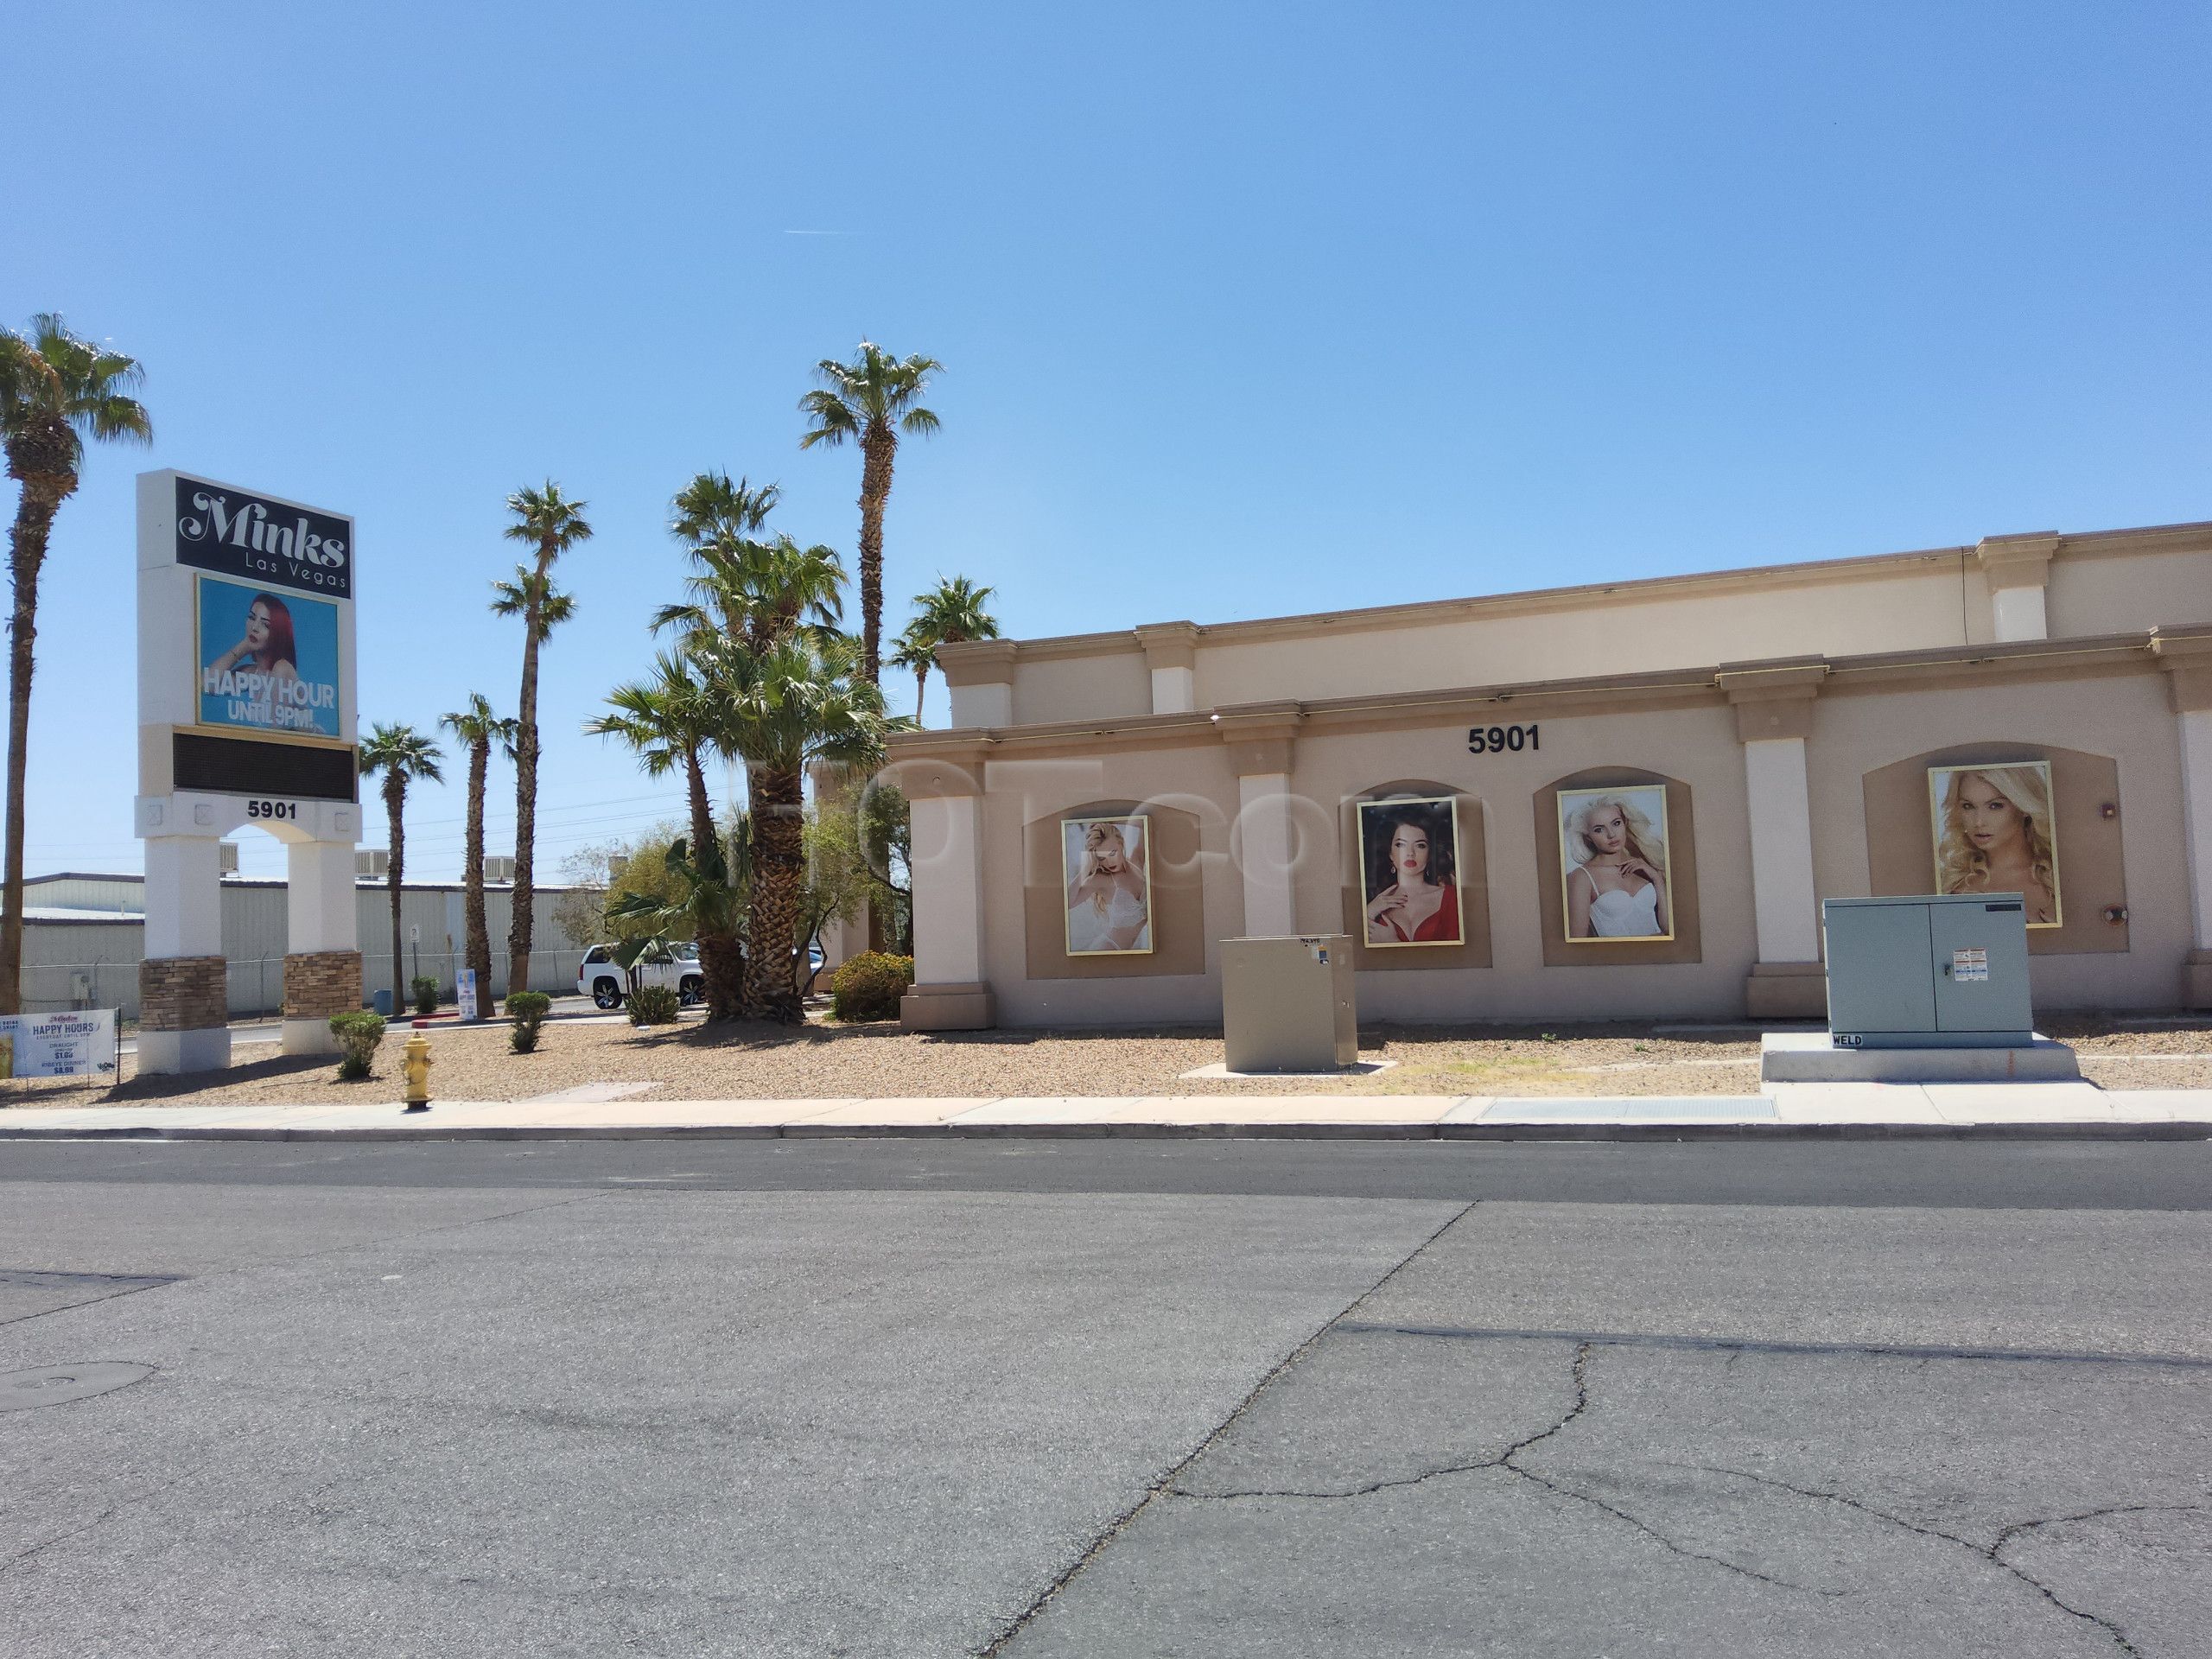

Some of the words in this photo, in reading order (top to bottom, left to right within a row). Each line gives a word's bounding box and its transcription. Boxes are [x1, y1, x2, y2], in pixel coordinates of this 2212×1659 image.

[178, 492, 346, 568] Minks
[245, 552, 277, 573] Las
[289, 562, 346, 588] Vegas
[203, 667, 275, 702] HAPPY
[278, 677, 334, 709] HOUR
[227, 700, 272, 724] UNTIL
[1468, 724, 1539, 753] 5901
[248, 800, 296, 819] 5901
[33, 1025, 62, 1035] HAPPY
[65, 1022, 94, 1033] HOURS
[1833, 1035, 1862, 1045] WELD
